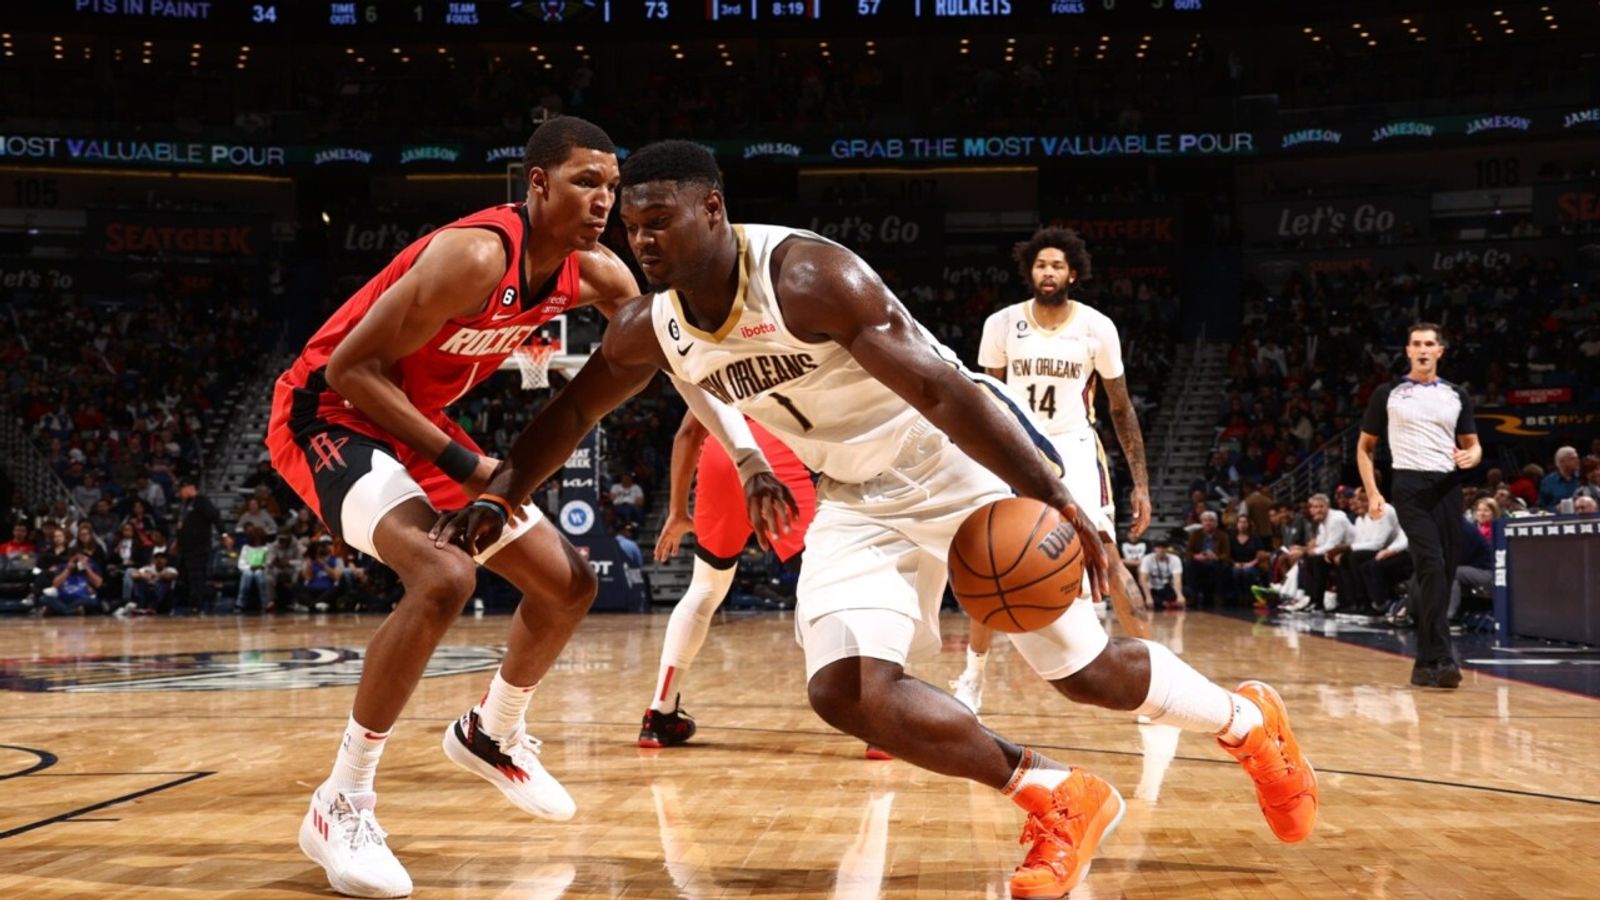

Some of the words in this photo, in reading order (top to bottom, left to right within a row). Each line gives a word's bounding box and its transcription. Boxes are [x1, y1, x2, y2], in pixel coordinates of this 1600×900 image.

[75, 0, 118, 14] PTS
[123, 0, 144, 15] IN
[150, 0, 211, 19] PAINT
[251, 4, 278, 23] 34
[330, 3, 357, 13] TIME
[364, 5, 378, 23] 6
[412, 5, 423, 23] 1
[448, 3, 477, 13] TEAM
[644, 1, 670, 19] 73
[720, 3, 742, 16] 3rd
[771, 2, 805, 17] 8:19
[857, 0, 881, 15] 57
[935, 0, 1013, 16] ROCKETS
[1051, 2, 1086, 14] FOULS
[328, 13, 358, 26] OUTS
[446, 13, 480, 25] FOULS
[1371, 120, 1436, 143] JAMESON
[1464, 114, 1534, 136] JAMESON
[830, 137, 905, 160] GRAB
[909, 137, 958, 159] THE
[962, 135, 1036, 158] MOST
[1039, 133, 1173, 158] VALUABLE
[1178, 131, 1254, 154] POUR
[1281, 127, 1343, 149] JAMESON
[66, 138, 205, 164] VALUABLE
[210, 143, 286, 166] POUR
[314, 147, 373, 166] JAMESON
[400, 145, 460, 165] JAMESON
[743, 142, 803, 160] JAMESON
[880, 214, 920, 243] Go
[1277, 205, 1346, 237] Let's
[1352, 203, 1396, 234] Go
[104, 220, 253, 255] SEATGEEK
[1432, 249, 1480, 271] Let's
[1482, 247, 1512, 271] Go
[0, 268, 40, 289] et's
[502, 288, 515, 305] 6
[741, 322, 777, 339] ibotta
[724, 352, 820, 401] ORLEANS
[1035, 356, 1083, 380] ORLEANS
[1026, 384, 1057, 420] 14
[768, 392, 815, 433] 1
